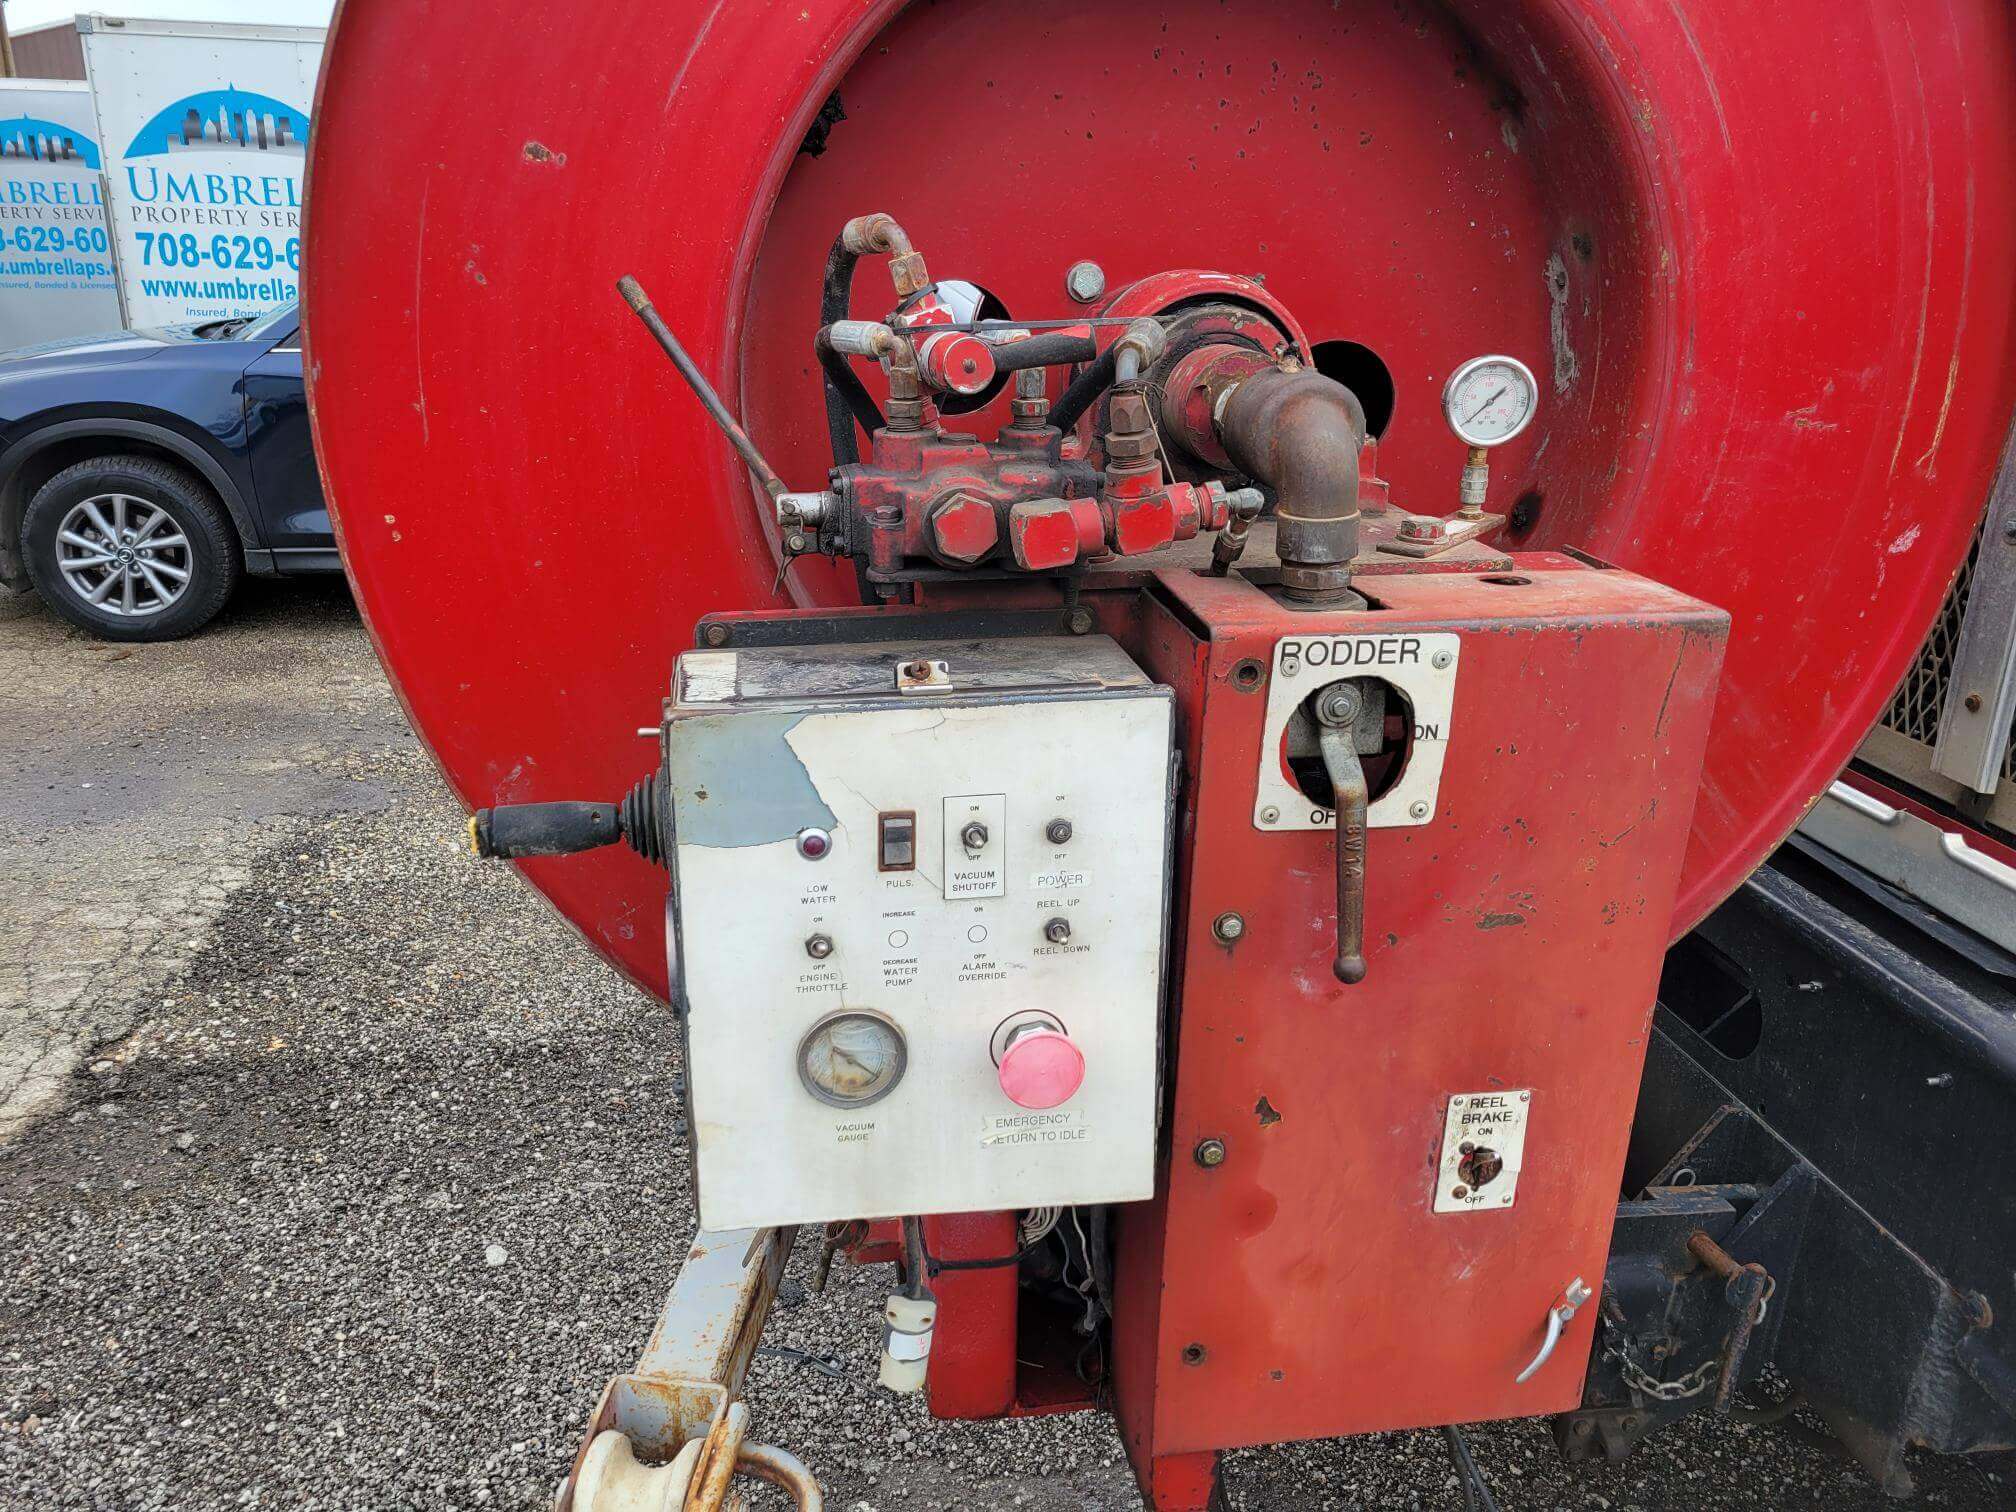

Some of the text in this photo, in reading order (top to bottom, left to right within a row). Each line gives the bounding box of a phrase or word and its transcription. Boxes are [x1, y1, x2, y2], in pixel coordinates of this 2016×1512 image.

[130, 206, 249, 226] PROPERTY
[135, 232, 301, 271] 708-629-6
[141, 277, 298, 301] www.umbrella
[186, 307, 230, 318] Insured,
[1280, 638, 1421, 666] RODDER
[1415, 724, 1439, 740] ON
[1310, 810, 1335, 824] OF
[954, 870, 995, 880] VACUUM
[1037, 874, 1083, 886] POWER
[806, 885, 828, 893] LOW
[886, 879, 914, 889] PULS.
[952, 882, 998, 892] SHUTOFF
[800, 895, 837, 905] WATER
[1037, 898, 1080, 909] REEL UP
[882, 910, 916, 918] INCREASE
[1033, 944, 1091, 956] REEL DOWN
[882, 957, 918, 966] DECREASE
[962, 962, 996, 971] ALARM
[883, 967, 918, 976] WATER
[958, 971, 1007, 982] OVERRIDE
[800, 972, 838, 983] ENGINE
[885, 979, 912, 987] PUMP
[796, 982, 849, 993] THROTTLE
[1470, 1097, 1508, 1109] REEL
[996, 1113, 1071, 1128] EMERGENCY
[1461, 1111, 1513, 1125] BRAKE
[836, 1123, 875, 1132] VACUUM
[1477, 1127, 1494, 1136] ON
[838, 1133, 869, 1142] GAUGE
[993, 1129, 1086, 1144] ETURN TO IDLE
[1464, 1195, 1486, 1204] OFF
